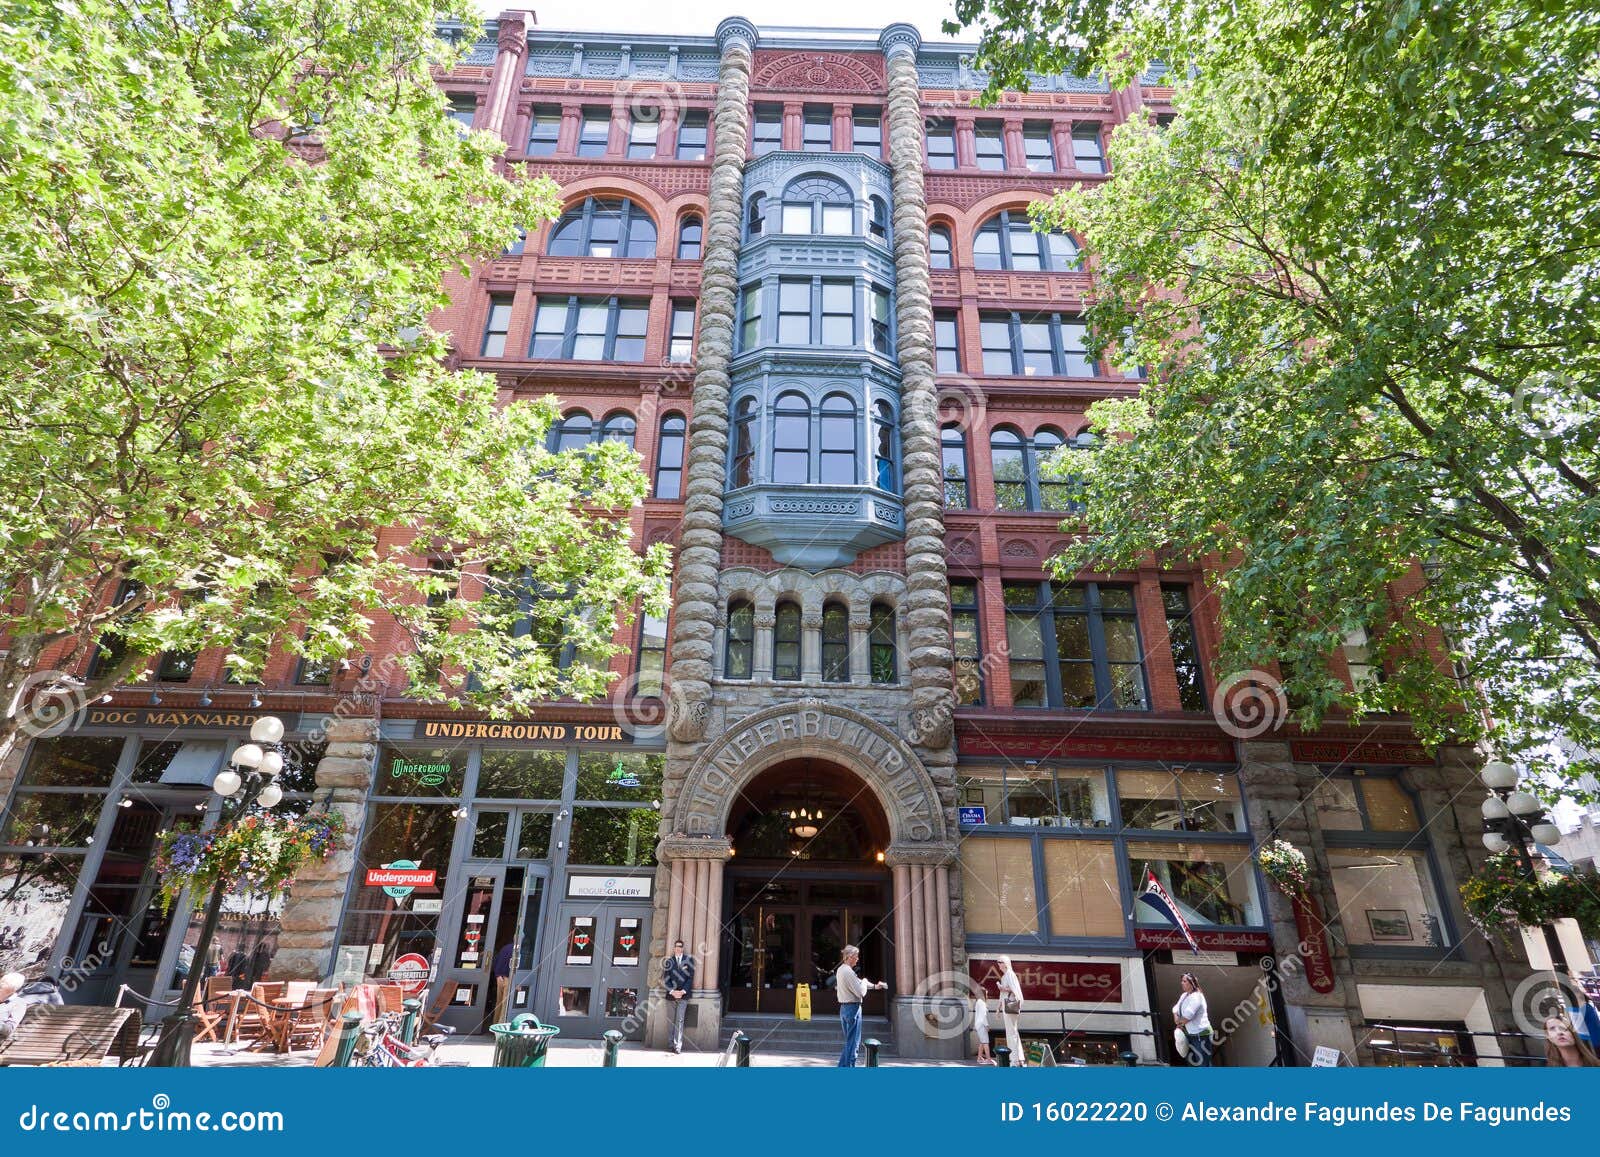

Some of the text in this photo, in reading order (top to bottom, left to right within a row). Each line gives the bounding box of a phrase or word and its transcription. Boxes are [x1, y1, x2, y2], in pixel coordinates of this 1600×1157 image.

[828, 55, 882, 90] BUILDING
[90, 712, 263, 727] DOC MAYNARD
[424, 722, 623, 740] UNDERGROUND TOUR
[392, 759, 451, 778] UNDERGROUND
[368, 872, 434, 884] Underground
[391, 887, 407, 895] Tour
[607, 888, 641, 896] GALLERY
[1202, 932, 1267, 946] Collectibles
[980, 964, 1112, 999] Atiques
